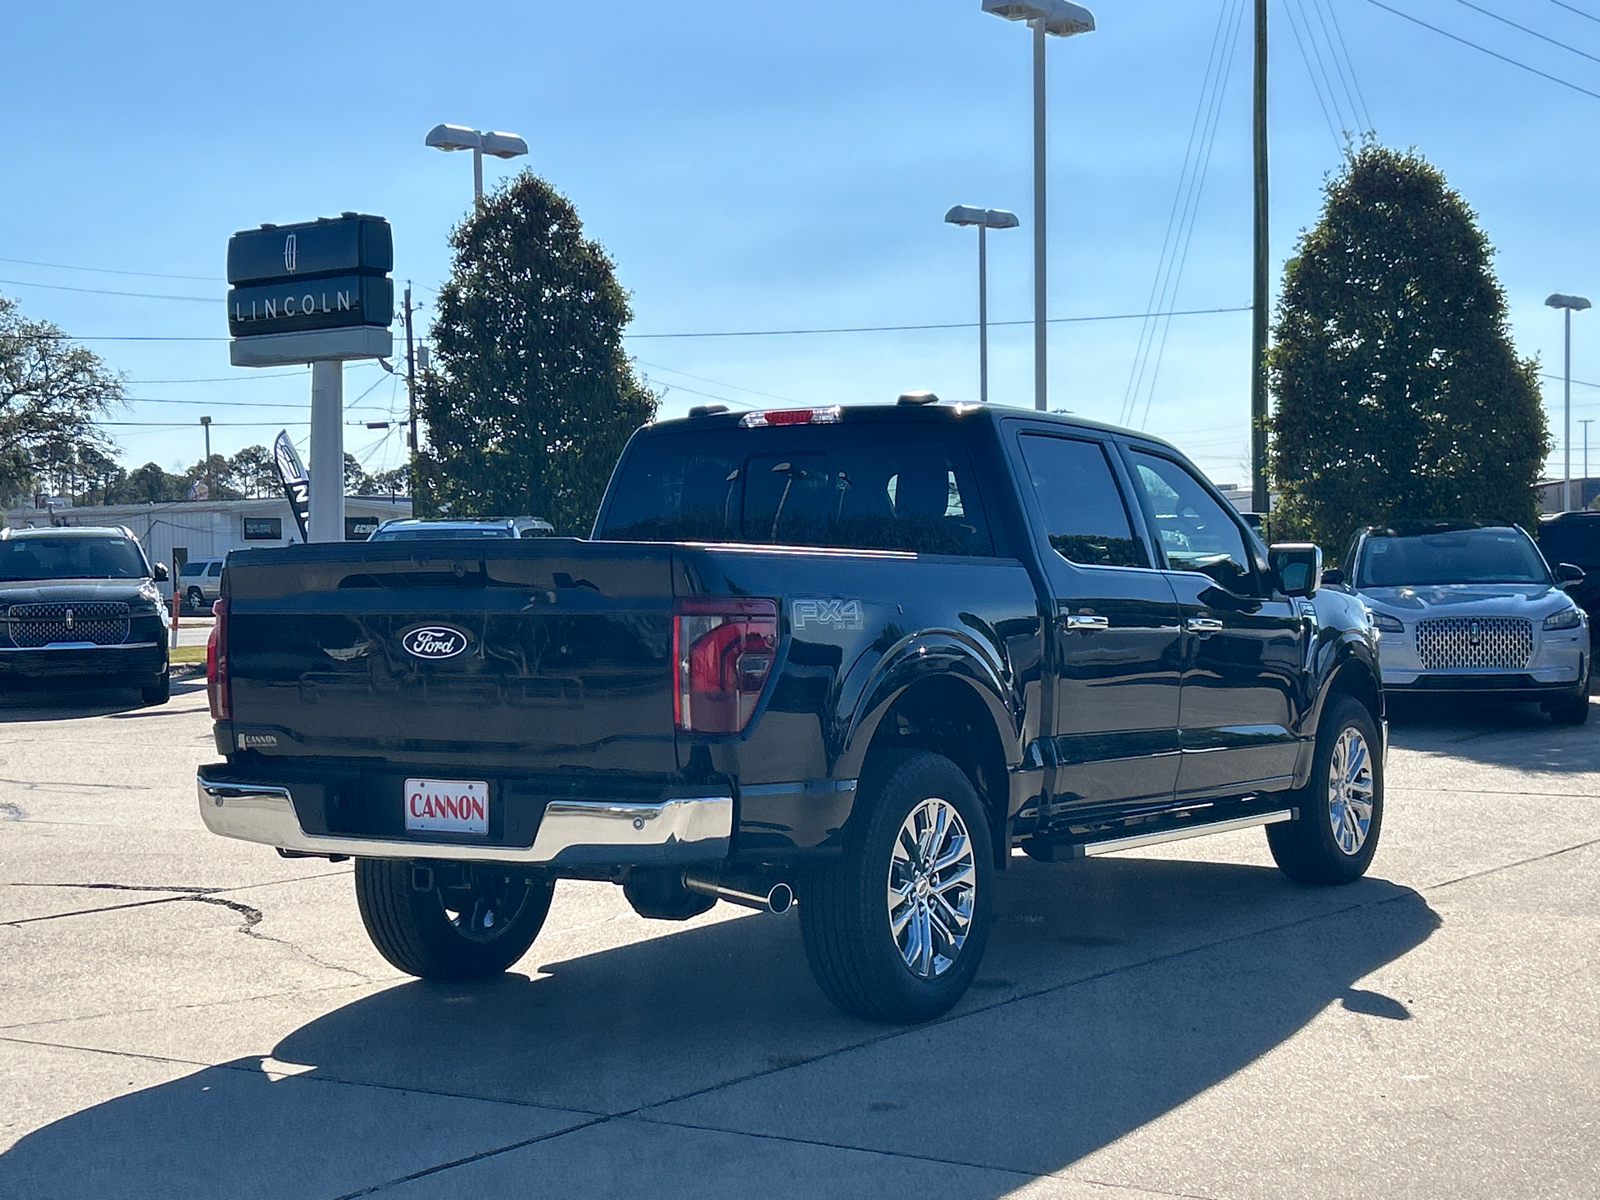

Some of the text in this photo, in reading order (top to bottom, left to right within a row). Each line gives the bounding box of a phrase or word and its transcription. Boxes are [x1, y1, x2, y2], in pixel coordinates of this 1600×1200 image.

[236, 290, 350, 322] LINCOLN
[792, 600, 864, 630] FX4
[413, 631, 455, 653] Ford
[245, 735, 277, 744] CANNON
[410, 793, 484, 820] CANNON
